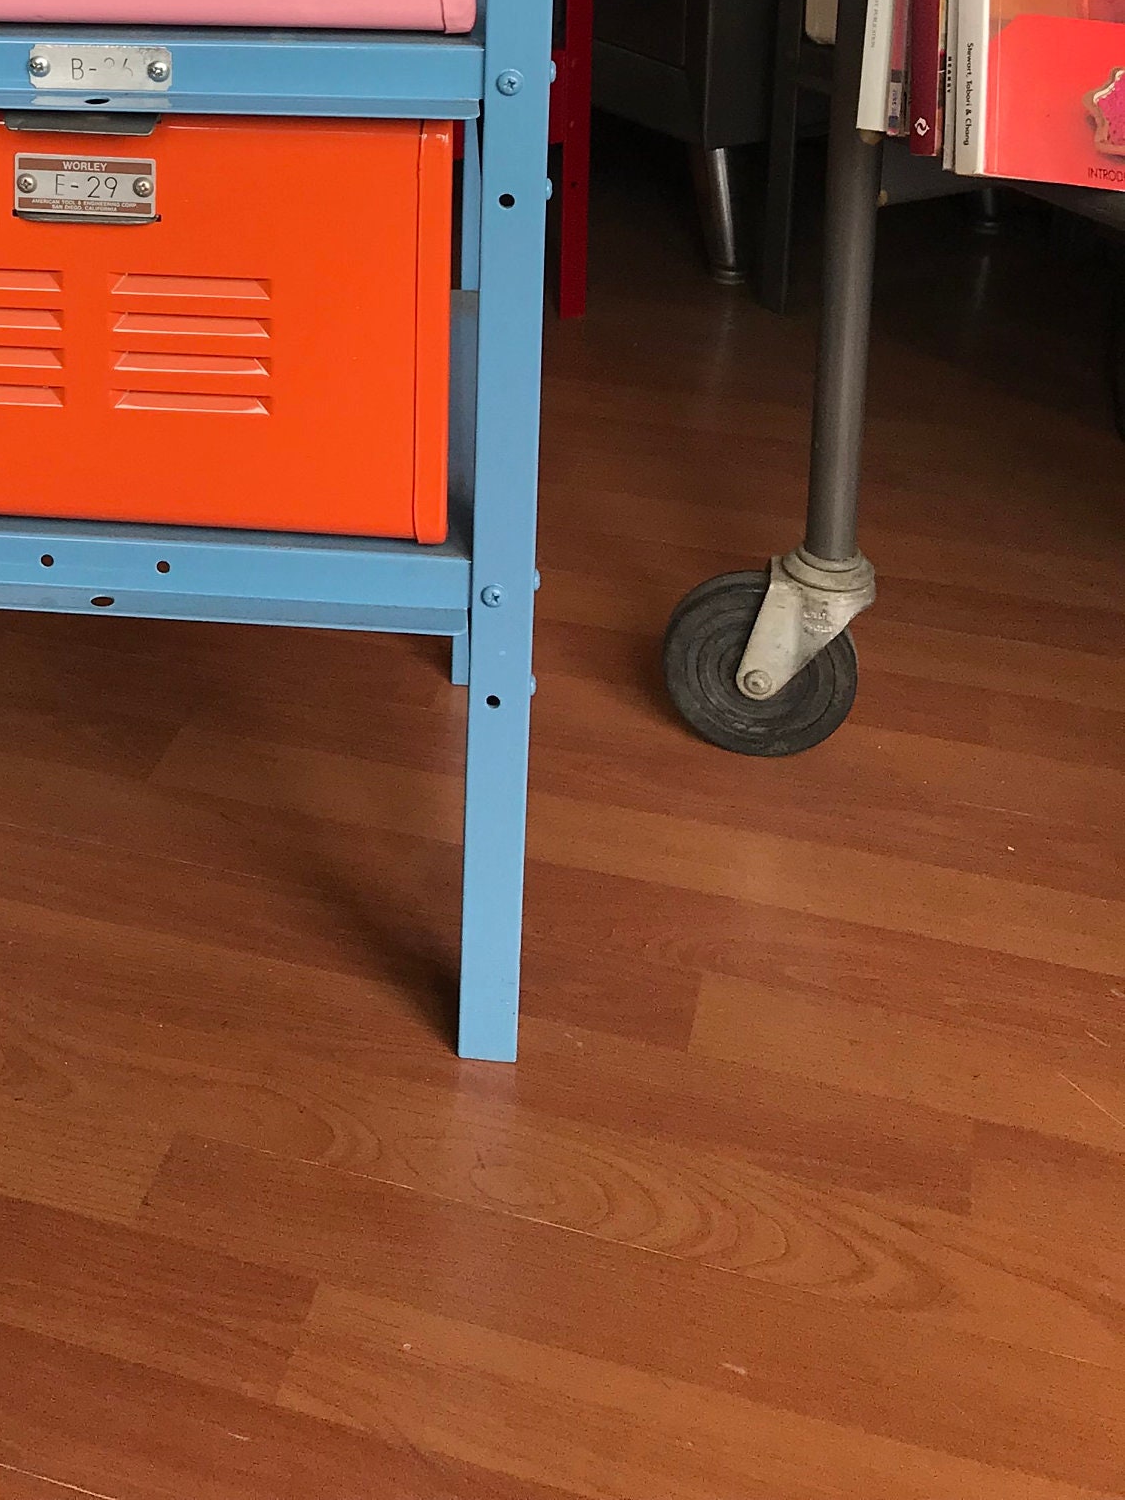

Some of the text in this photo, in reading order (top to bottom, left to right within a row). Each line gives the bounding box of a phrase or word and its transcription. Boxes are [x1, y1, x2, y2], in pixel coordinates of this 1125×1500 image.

[962, 118, 972, 146] Chang
[62, 160, 108, 172] WORLEY
[1087, 166, 1125, 182] INTROD
[55, 173, 118, 198] E-29
